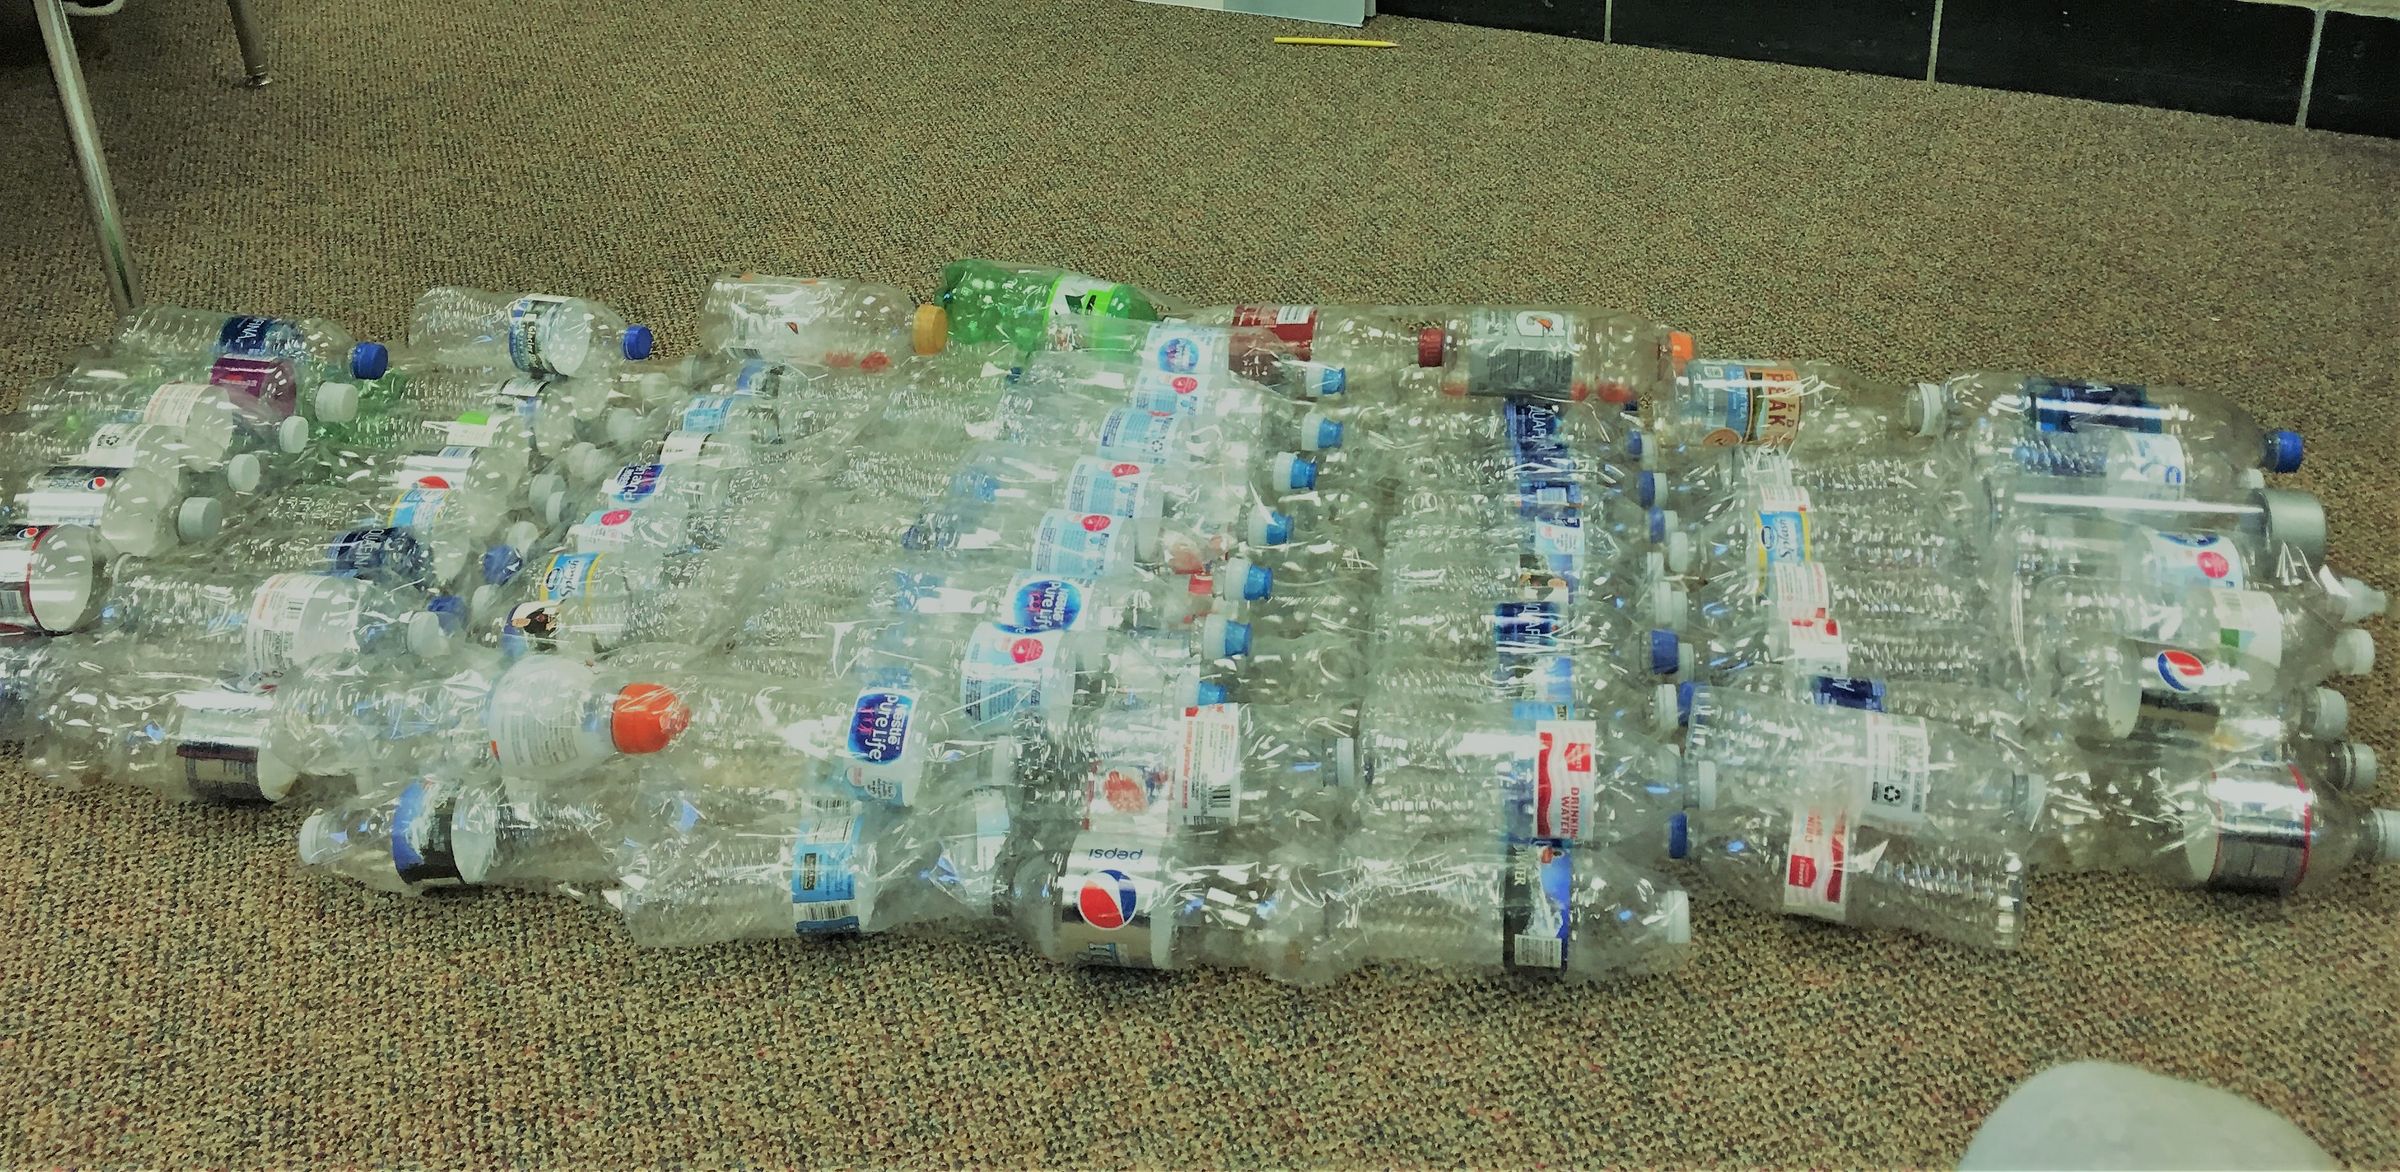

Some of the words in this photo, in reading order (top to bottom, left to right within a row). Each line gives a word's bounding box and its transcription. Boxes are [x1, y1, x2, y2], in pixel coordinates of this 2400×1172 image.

[237, 316, 267, 340] FINA
[1766, 372, 1787, 426] PEAK
[1784, 373, 1797, 428] GLD
[1042, 581, 1062, 607] Pure
[875, 694, 899, 728] Pure
[865, 729, 887, 760] Life
[1560, 796, 1570, 834] WATER
[1089, 847, 1144, 862] pepsi
